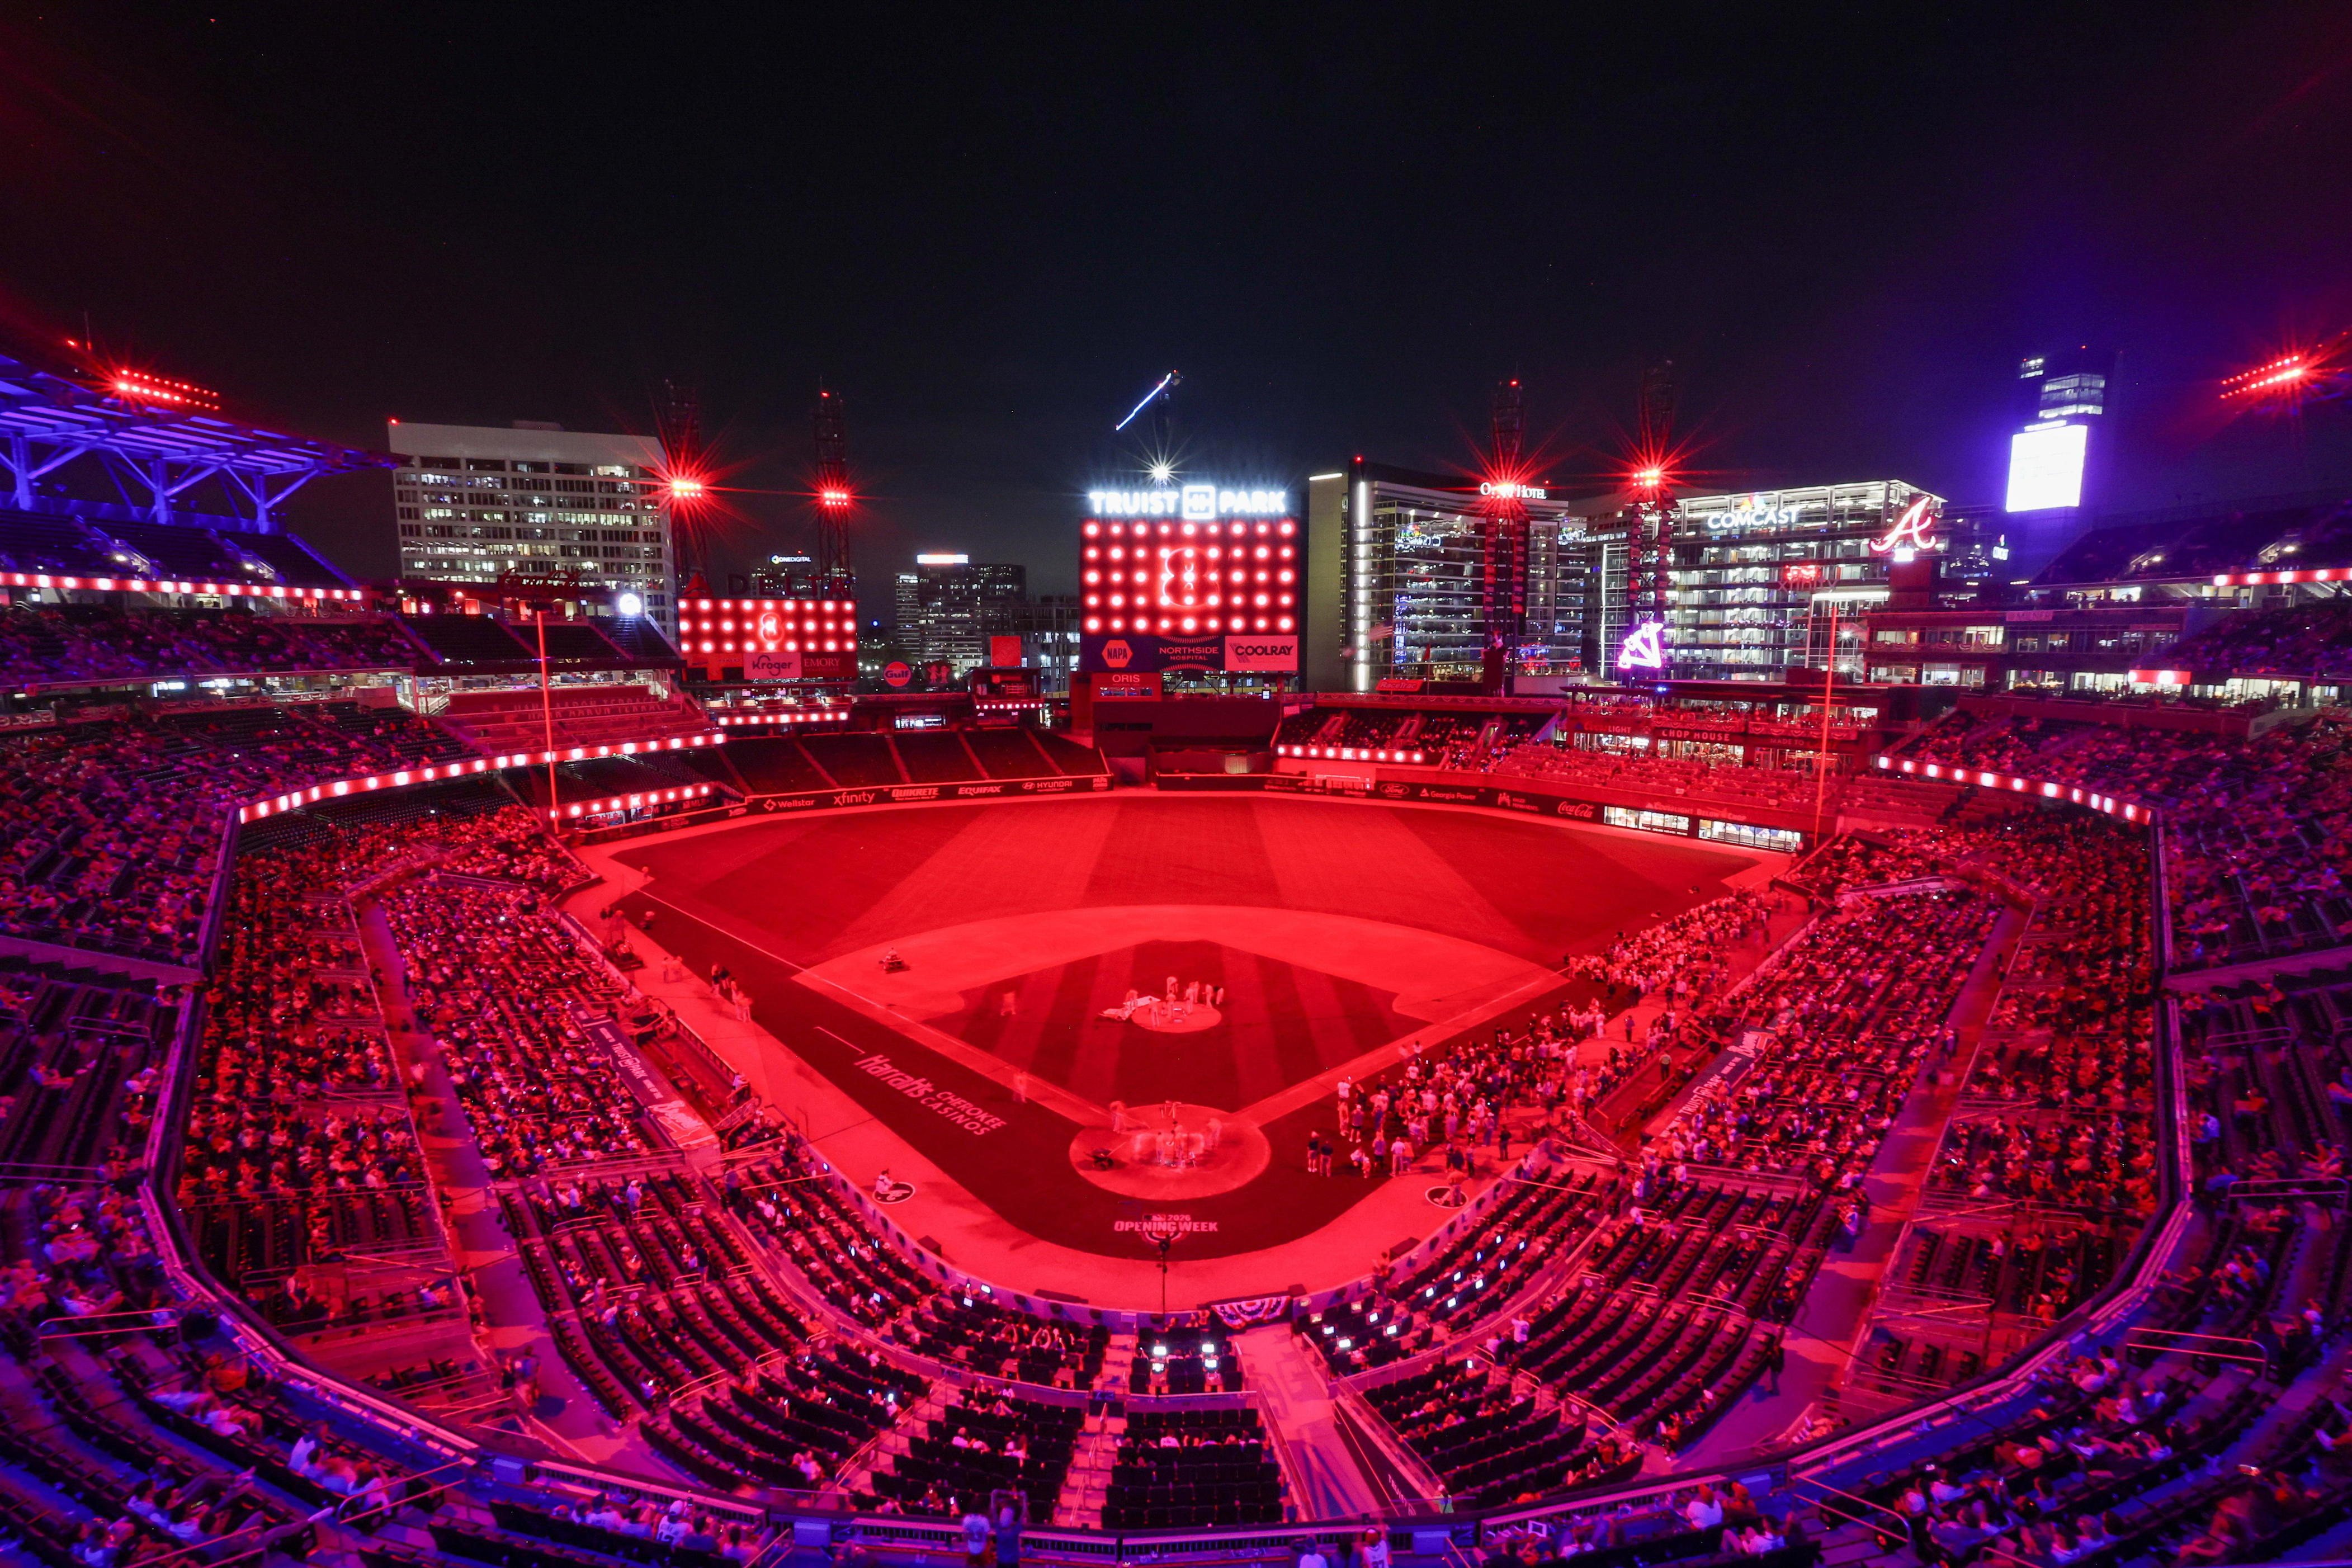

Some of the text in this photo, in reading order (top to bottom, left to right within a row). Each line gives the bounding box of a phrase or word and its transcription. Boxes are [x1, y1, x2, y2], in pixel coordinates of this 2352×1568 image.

[1089, 492, 1286, 513] TRUIST PARK
[1708, 508, 1801, 529] COMCAST
[1107, 648, 1127, 659] NAPA
[1235, 645, 1293, 656] COOLRAY
[753, 655, 792, 677] Kroger
[804, 658, 841, 667] EMORY
[1112, 674, 1140, 683] ORIS
[1662, 730, 1689, 738] CHOP
[891, 787, 939, 798] QUIKRETE
[958, 786, 1002, 796] EQUIFAX
[1385, 785, 1404, 794] Ford
[1431, 791, 1454, 799] Georgia
[834, 791, 875, 806] xfinity
[778, 800, 815, 809] Wellstar
[611, 1042, 648, 1079] TRUIST PARK
[1679, 1074, 1723, 1115] TRUIST PARK
[936, 1091, 1007, 1130] CHEROKEE
[920, 1097, 990, 1136] CASINOS
[1114, 1221, 1218, 1232] OPENING WEEK
